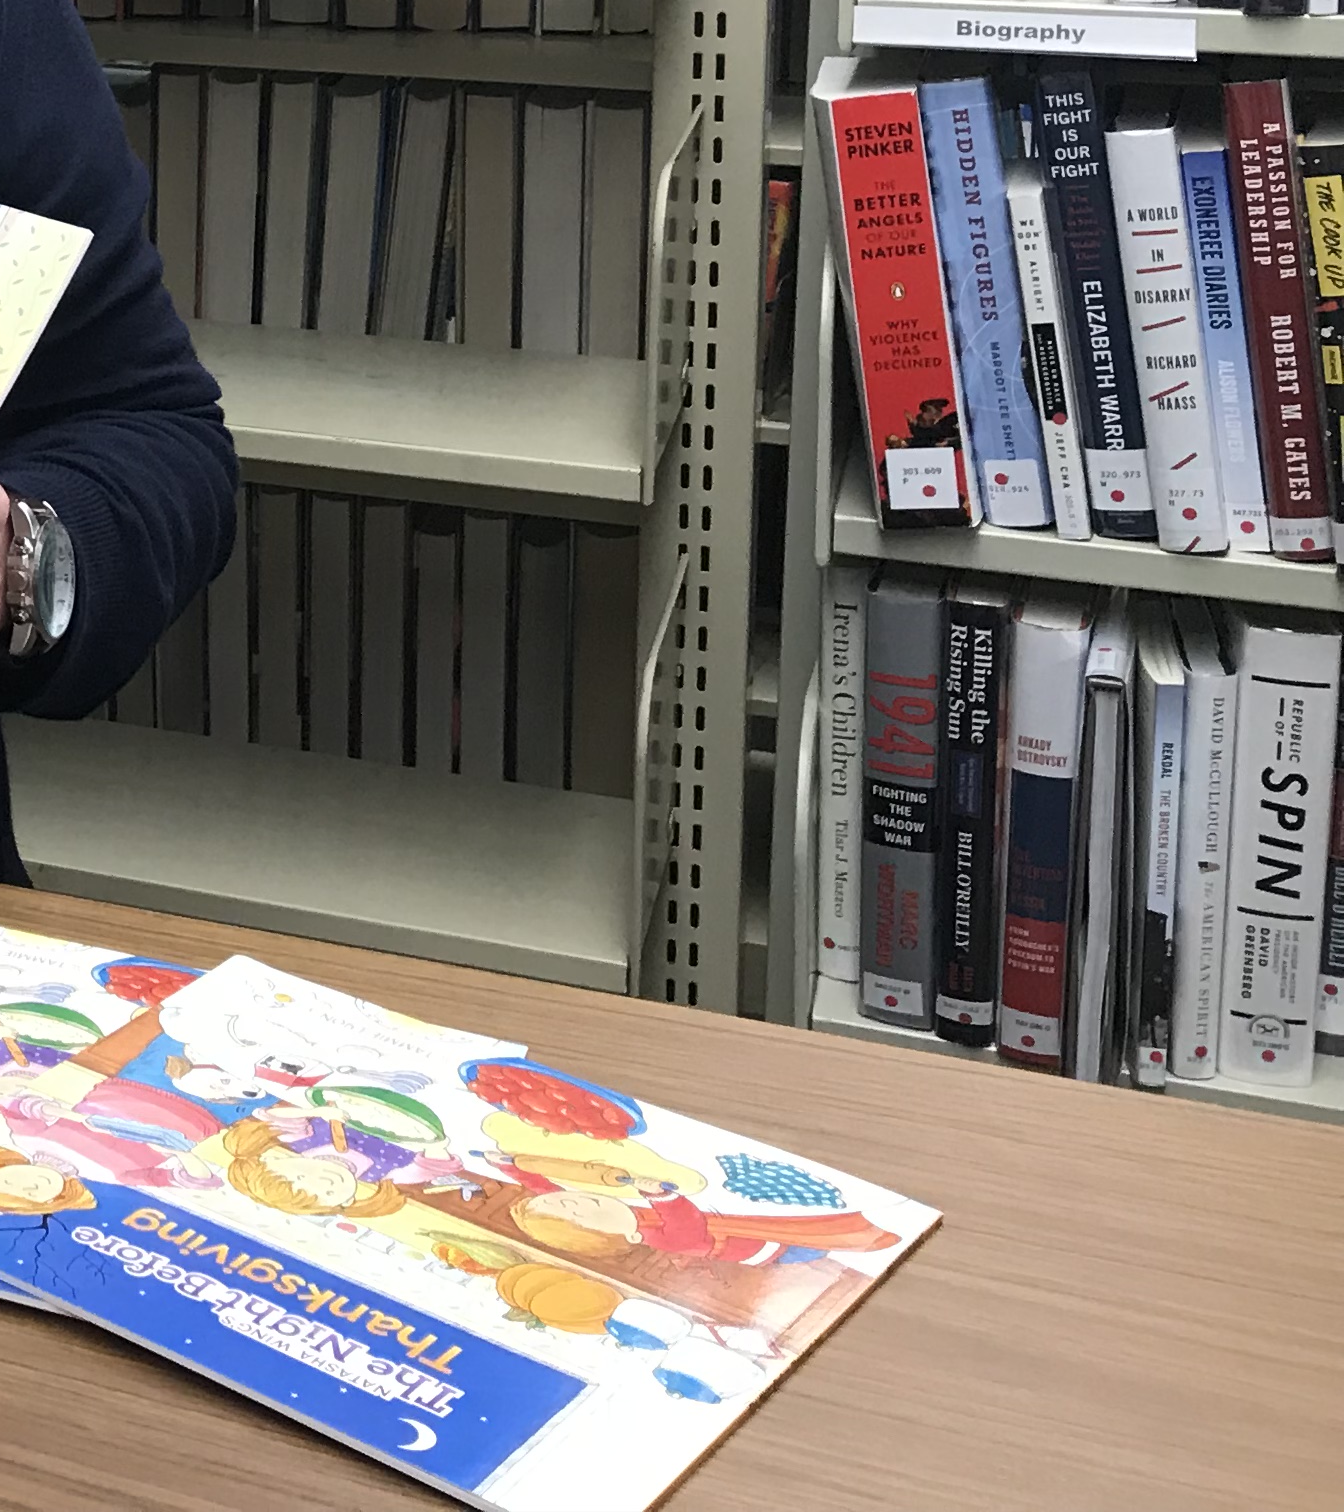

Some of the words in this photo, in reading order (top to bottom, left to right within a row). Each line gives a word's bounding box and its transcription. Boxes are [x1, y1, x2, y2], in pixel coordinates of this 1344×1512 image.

[956, 20, 1086, 44] Biography
[1043, 109, 1091, 126] FIGHT
[1044, 93, 1085, 107] THIS
[845, 121, 913, 142] STEVEN
[848, 139, 914, 159] PINKER
[1054, 146, 1091, 161] OUR
[1061, 129, 1079, 142] IS
[1051, 162, 1099, 179] FIGHT
[1266, 145, 1292, 230] PASSION
[854, 193, 922, 212] BETTER
[857, 213, 923, 229] ANGELS
[951, 109, 981, 206] HIDDEN
[968, 216, 999, 321] FIGURES
[1138, 206, 1178, 221] WORLD
[1191, 176, 1224, 260] EXONEREE
[1239, 139, 1272, 266] LEADERSHIP
[861, 243, 927, 260] NATURE
[1277, 242, 1297, 280] FOR
[1135, 289, 1191, 304] DISARRAY
[1082, 280, 1119, 388] ELIZABETH
[1270, 315, 1300, 395] ROBERT
[1146, 354, 1197, 370] RICHARD
[1284, 438, 1312, 501] GATES
[832, 602, 858, 686] Irena's
[947, 622, 968, 693] Rising
[968, 628, 993, 704] Killing
[867, 670, 937, 779] 1941
[948, 696, 965, 740] Sun
[971, 709, 991, 745] the
[1211, 697, 1225, 744] DAVID
[1288, 698, 1305, 764] REPUBLIC
[831, 692, 856, 797] Children
[873, 785, 927, 804] FIGHTING
[889, 803, 912, 817] THE
[1205, 749, 1224, 853] McCULLOUGH
[873, 814, 925, 833] SHADOW
[884, 831, 912, 846] WAR
[1255, 766, 1309, 900] SPIN
[1241, 924, 1256, 999] GREENBERG
[1258, 928, 1271, 967] DAVID
[72, 1226, 216, 1301] Before
[121, 1208, 464, 1375] Thanksgiving
[214, 1288, 367, 1364] Night
[220, 1314, 291, 1353] WING'S
[299, 1351, 392, 1398] NATASHA
[366, 1356, 464, 1416] The
